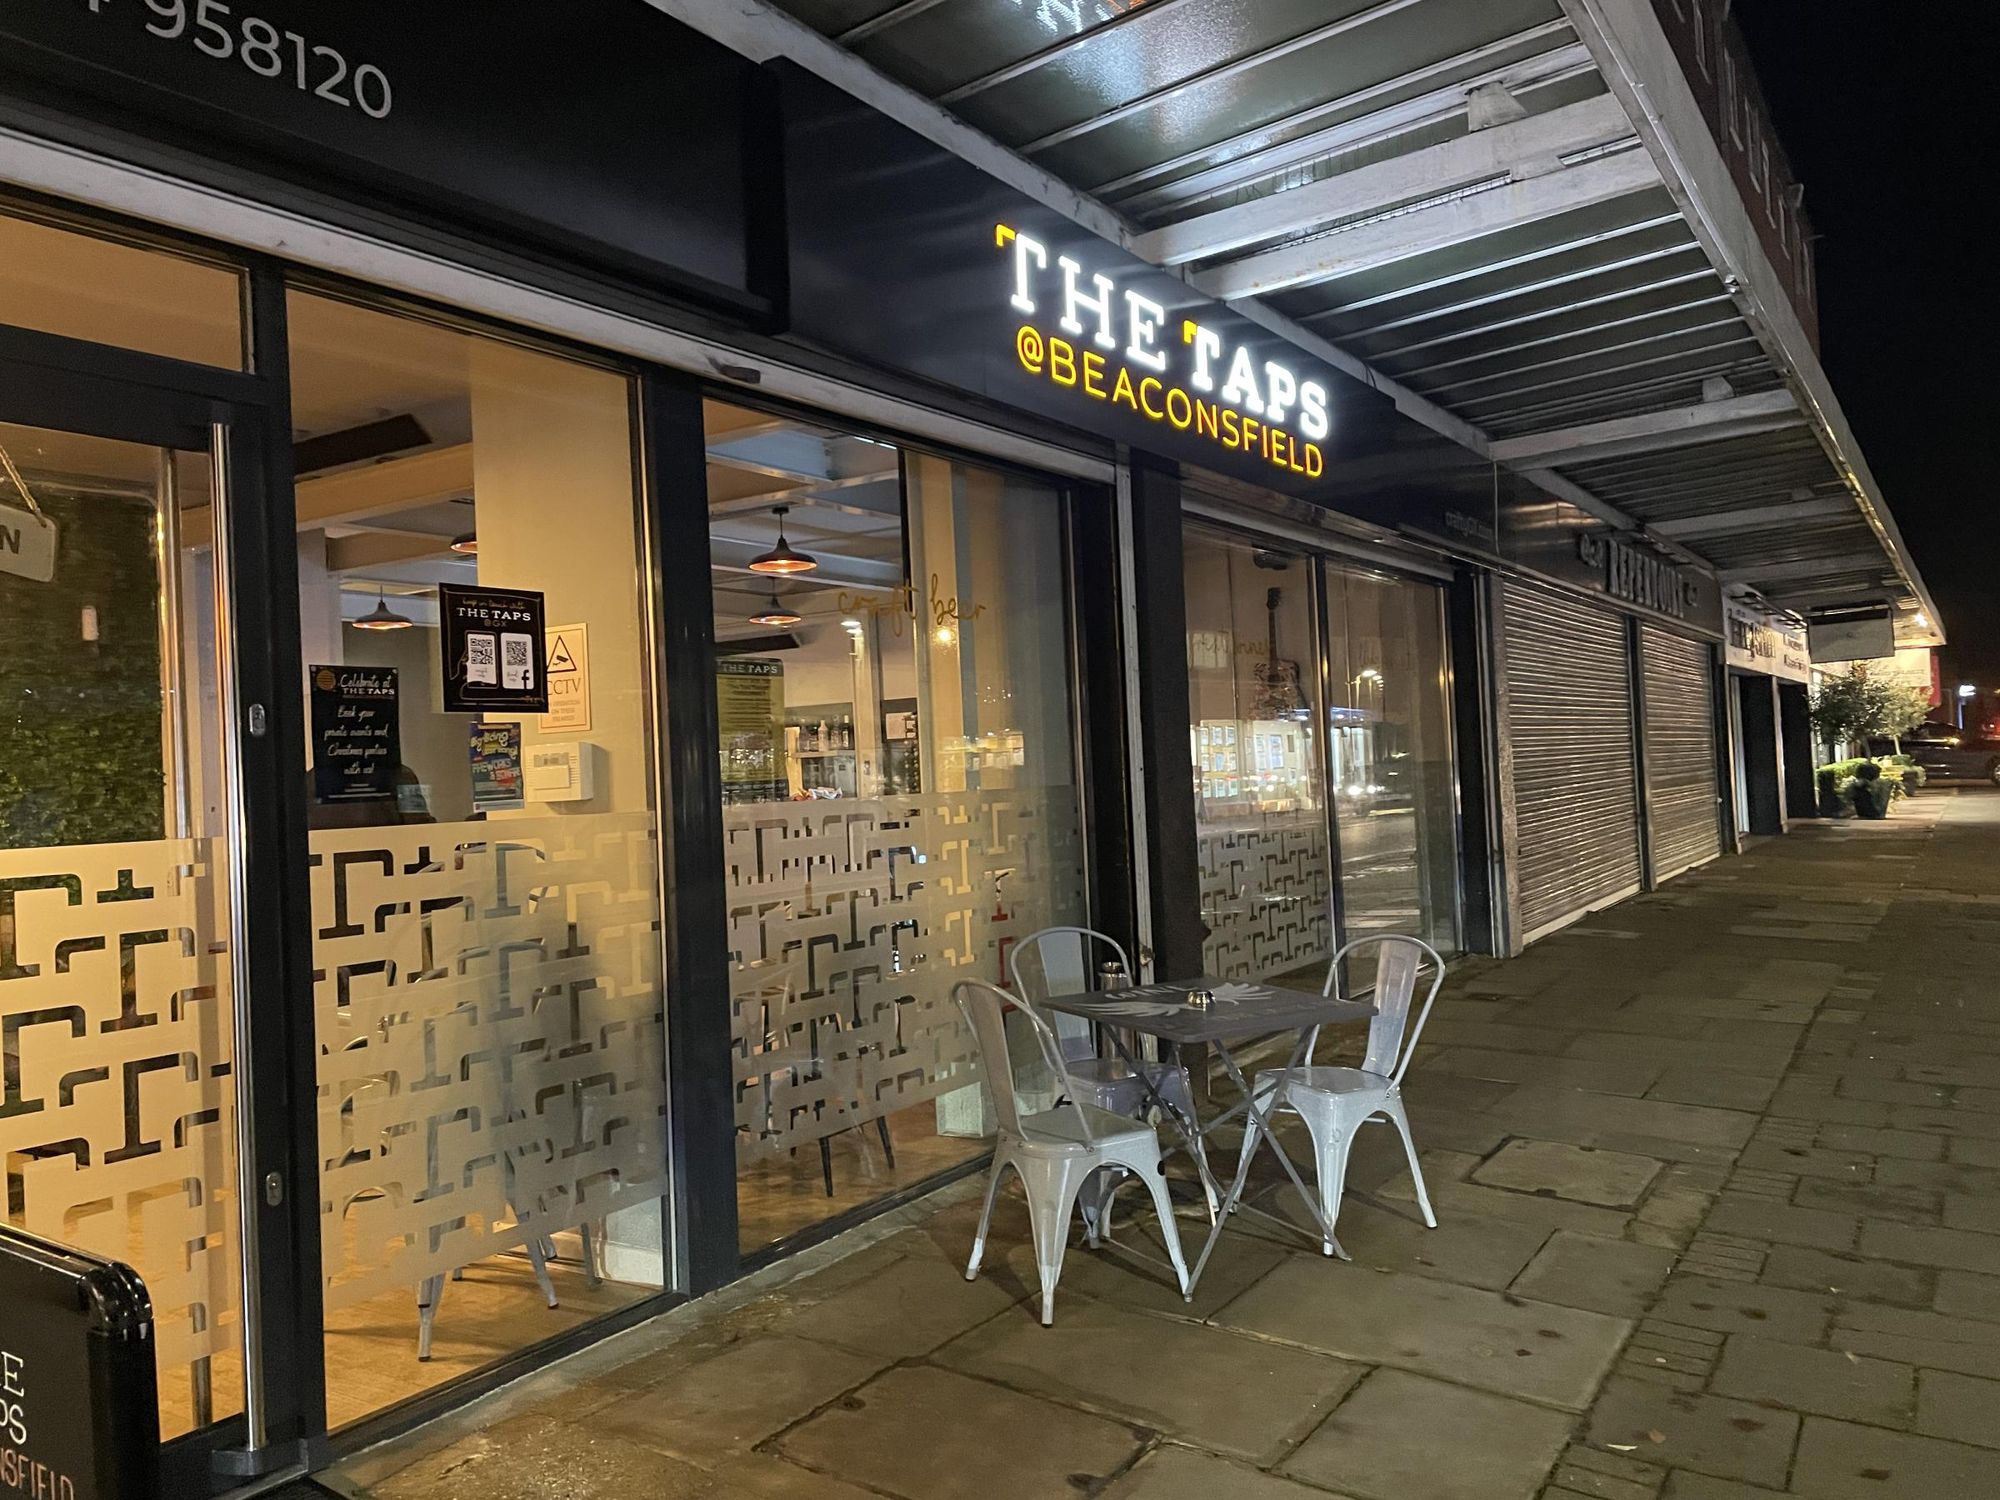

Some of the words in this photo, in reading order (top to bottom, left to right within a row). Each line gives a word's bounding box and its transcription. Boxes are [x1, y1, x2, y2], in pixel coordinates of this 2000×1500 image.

[145, 0, 392, 119] 958120
[995, 224, 1166, 372] THE
[1183, 320, 1330, 440] TAPS
[1016, 325, 1323, 478] @BEACONSFIELD
[457, 607, 489, 618] THE
[491, 610, 531, 621] TAPS
[930, 573, 986, 625] beer
[722, 663, 745, 673] THE
[747, 664, 778, 674] TAPS
